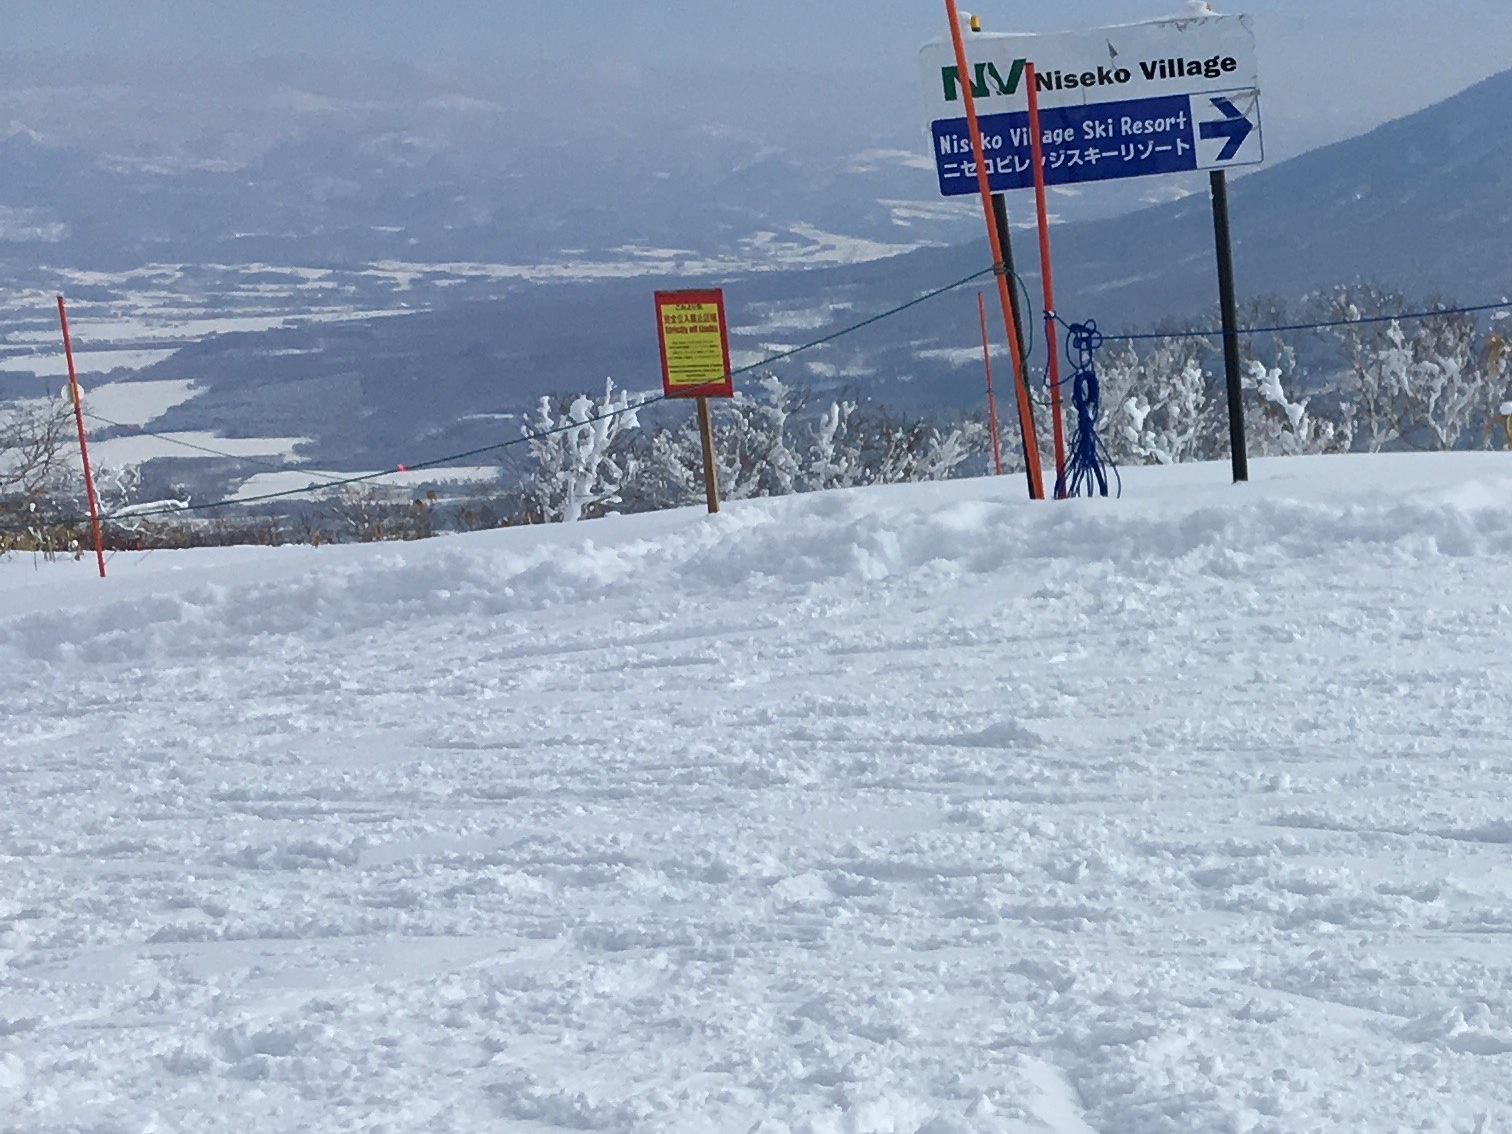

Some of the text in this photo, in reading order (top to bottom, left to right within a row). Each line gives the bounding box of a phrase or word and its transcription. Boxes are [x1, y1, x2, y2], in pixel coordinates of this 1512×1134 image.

[941, 58, 1027, 102] NV
[1035, 56, 1237, 92] Niseko Village
[940, 132, 1002, 155] Nisko
[1082, 118, 1113, 140] Ski
[1120, 111, 1187, 136] Resort
